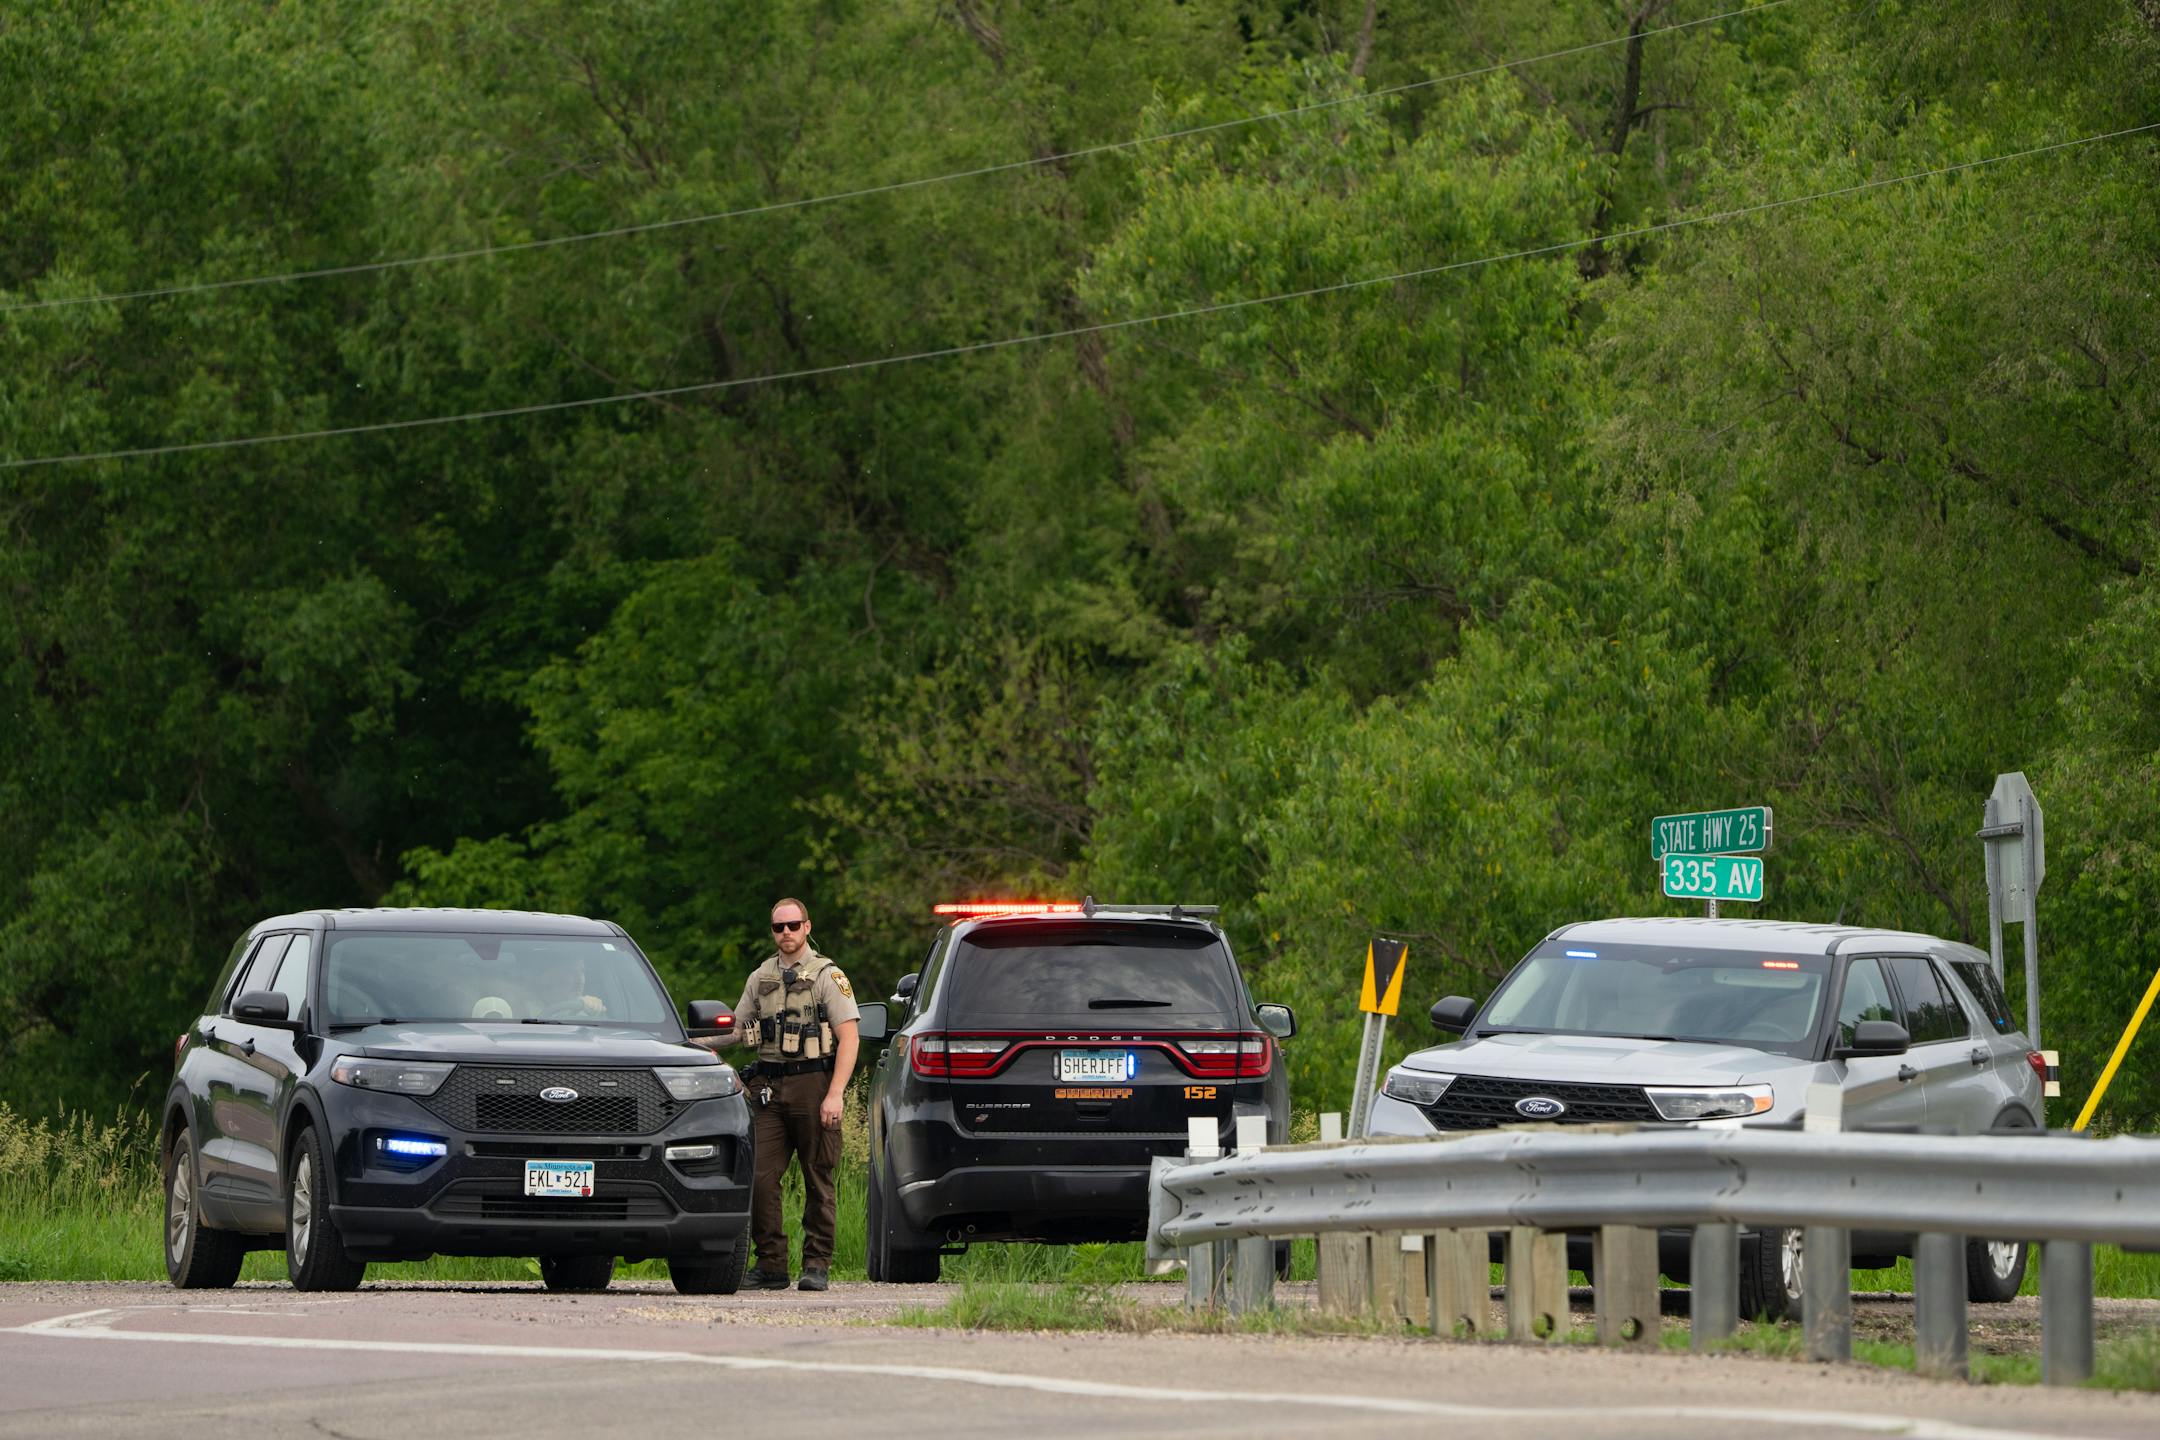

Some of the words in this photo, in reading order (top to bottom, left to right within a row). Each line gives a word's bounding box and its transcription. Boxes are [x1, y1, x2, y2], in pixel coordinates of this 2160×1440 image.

[1660, 819, 1696, 854] STATE
[1703, 816, 1732, 849] HWY
[1738, 814, 1757, 846] 25
[1670, 860, 1716, 892] 335
[1727, 862, 1757, 894] AV
[1064, 1058, 1124, 1074] SHERIFF
[1055, 1088, 1133, 1099] SHERIFF
[1183, 1086, 1217, 1099] 152
[1525, 1101, 1553, 1112] Ford
[529, 1170, 554, 1187] EKL
[564, 1170, 589, 1188] 521
